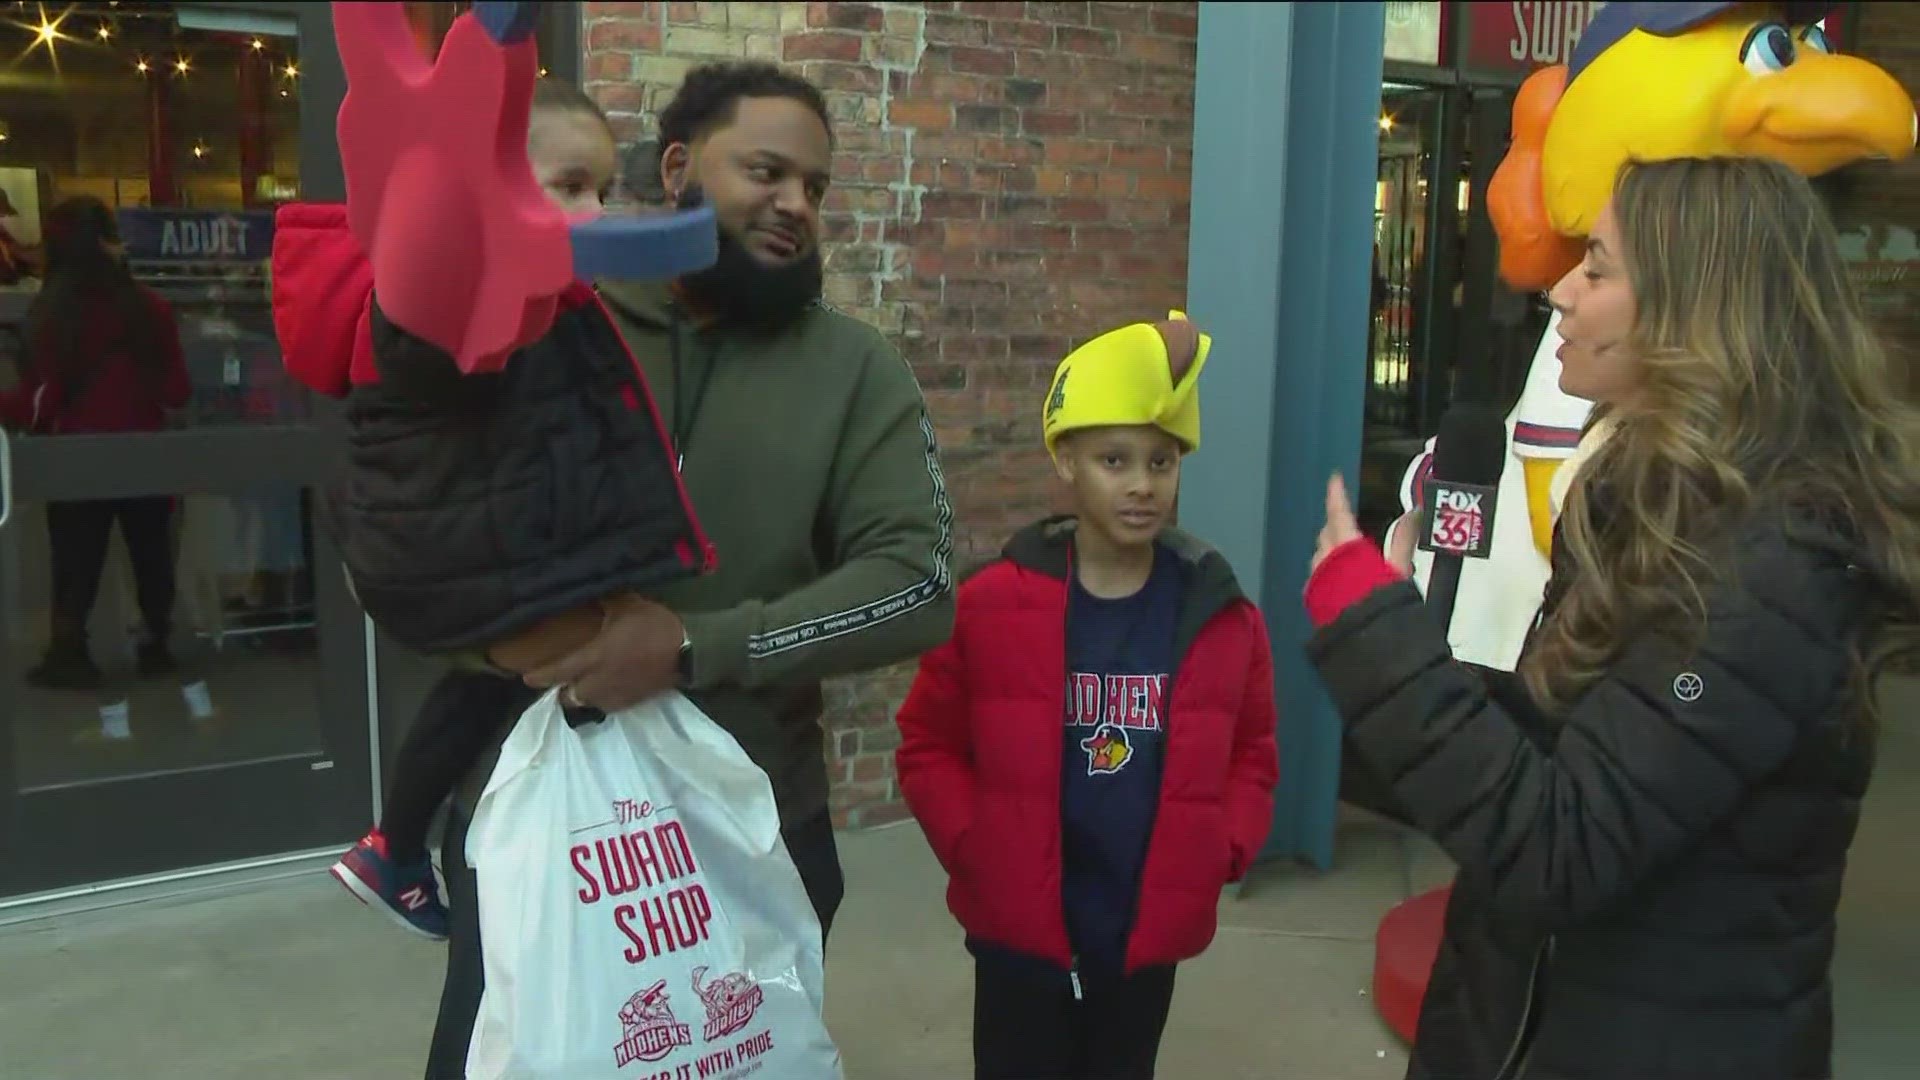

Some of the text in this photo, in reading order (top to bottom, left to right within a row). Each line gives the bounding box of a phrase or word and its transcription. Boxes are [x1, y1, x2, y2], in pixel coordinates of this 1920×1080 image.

[160, 217, 248, 255] ADULT
[1436, 489, 1483, 513] FOX
[1433, 513, 1468, 547] 36
[612, 800, 655, 825] The
[614, 884, 713, 965] SHOP
[695, 1048, 734, 1080] WITH
[736, 1029, 774, 1063] PRIDE
